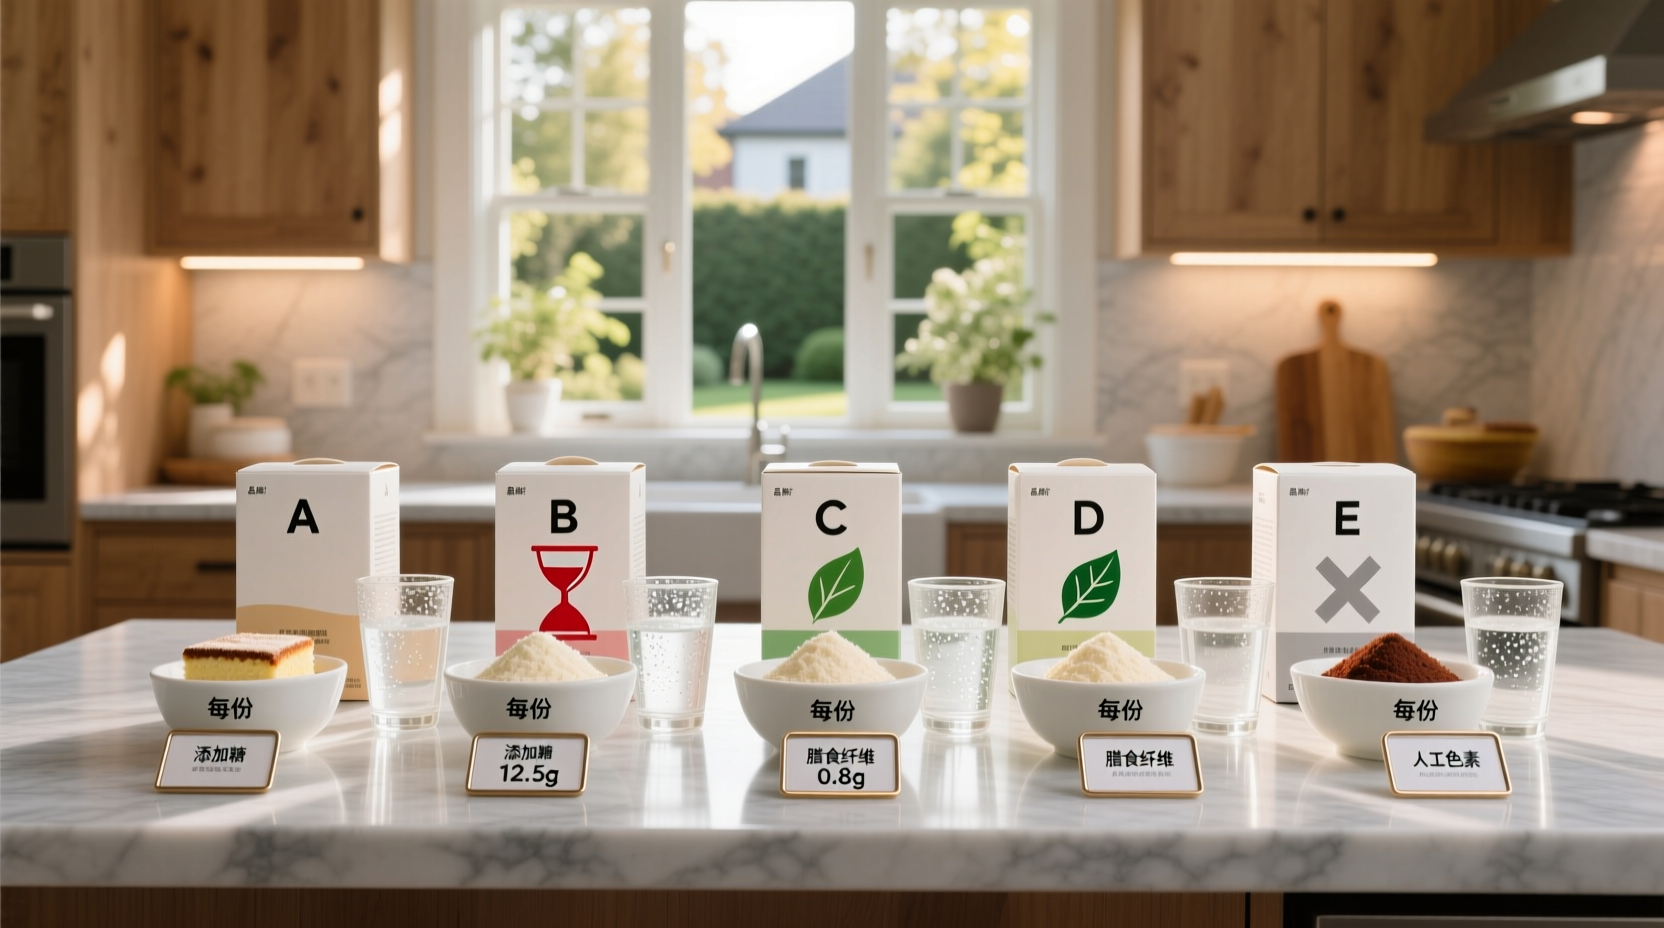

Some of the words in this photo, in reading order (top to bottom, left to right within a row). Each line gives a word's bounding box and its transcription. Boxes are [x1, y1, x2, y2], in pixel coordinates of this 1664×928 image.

[287, 499, 319, 533] A
[550, 500, 578, 533] B
[815, 500, 847, 535] C
[1074, 500, 1104, 535] D
[1335, 501, 1360, 535] E
[208, 696, 253, 720] 每份
[506, 697, 551, 720] 每份
[810, 699, 855, 722] 每份
[1098, 698, 1143, 721] 每份
[1393, 698, 1438, 721] 每份
[1413, 750, 1480, 768] 人工色素
[500, 764, 559, 787] 12.5g
[817, 768, 865, 789] 0.8g
